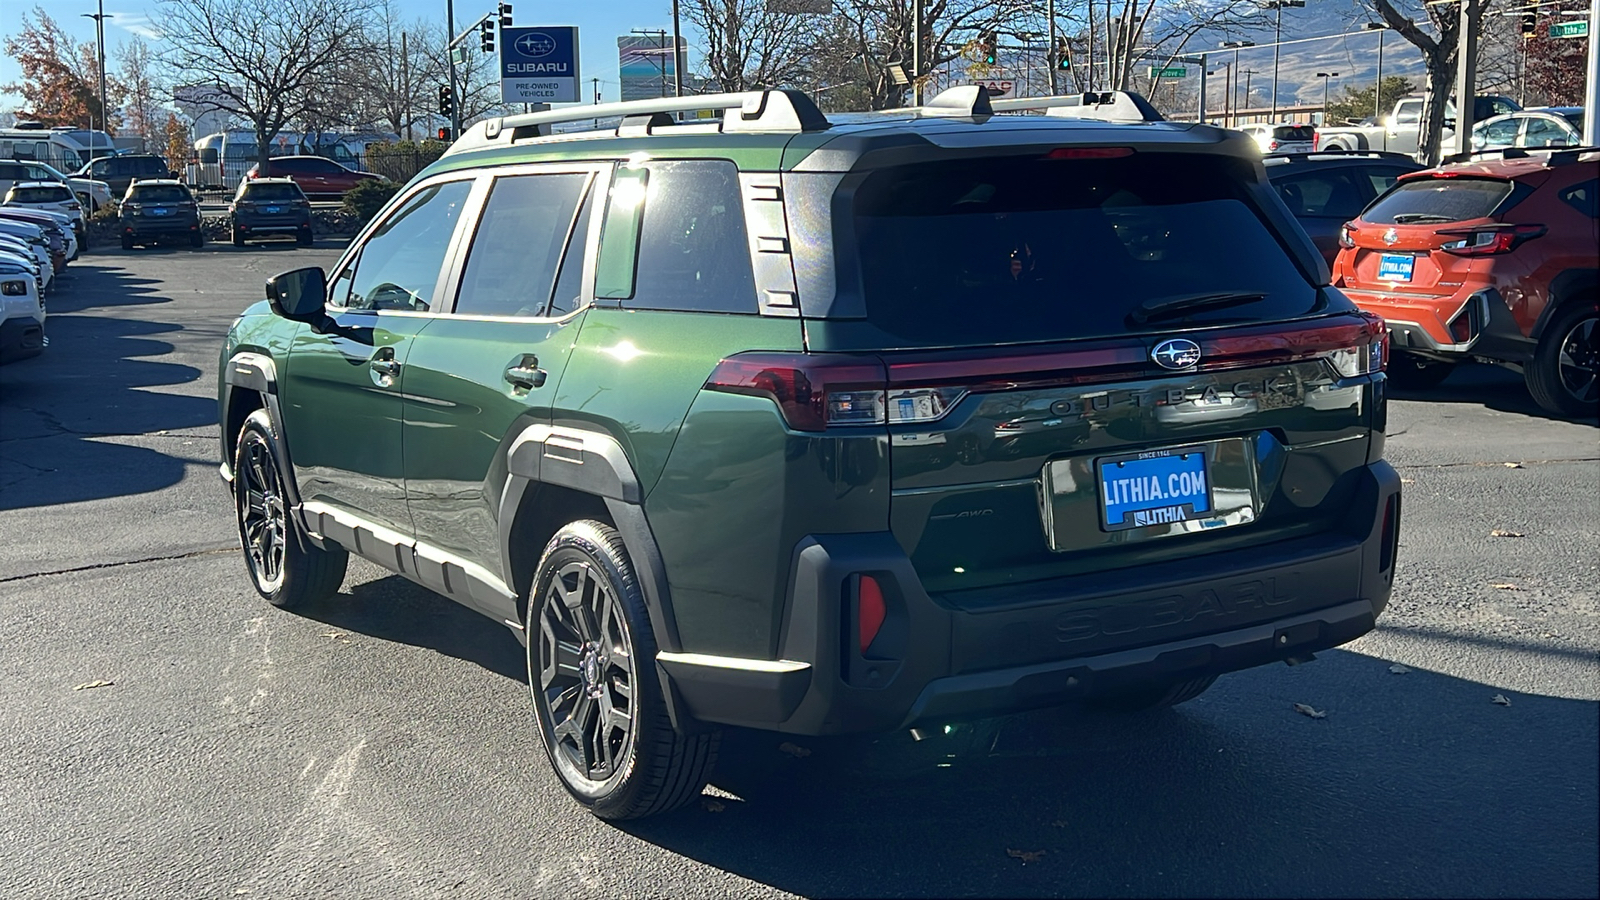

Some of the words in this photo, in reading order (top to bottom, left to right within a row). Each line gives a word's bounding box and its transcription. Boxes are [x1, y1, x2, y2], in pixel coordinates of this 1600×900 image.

[507, 63, 567, 73] SUBARU
[1050, 378, 1282, 417] OUTBACK
[1138, 451, 1156, 460] SINCE
[1103, 470, 1206, 506] LITHIA.COM
[954, 507, 993, 518] AWD
[1146, 506, 1187, 526] LITHIA
[1056, 573, 1297, 642] SUBARU
